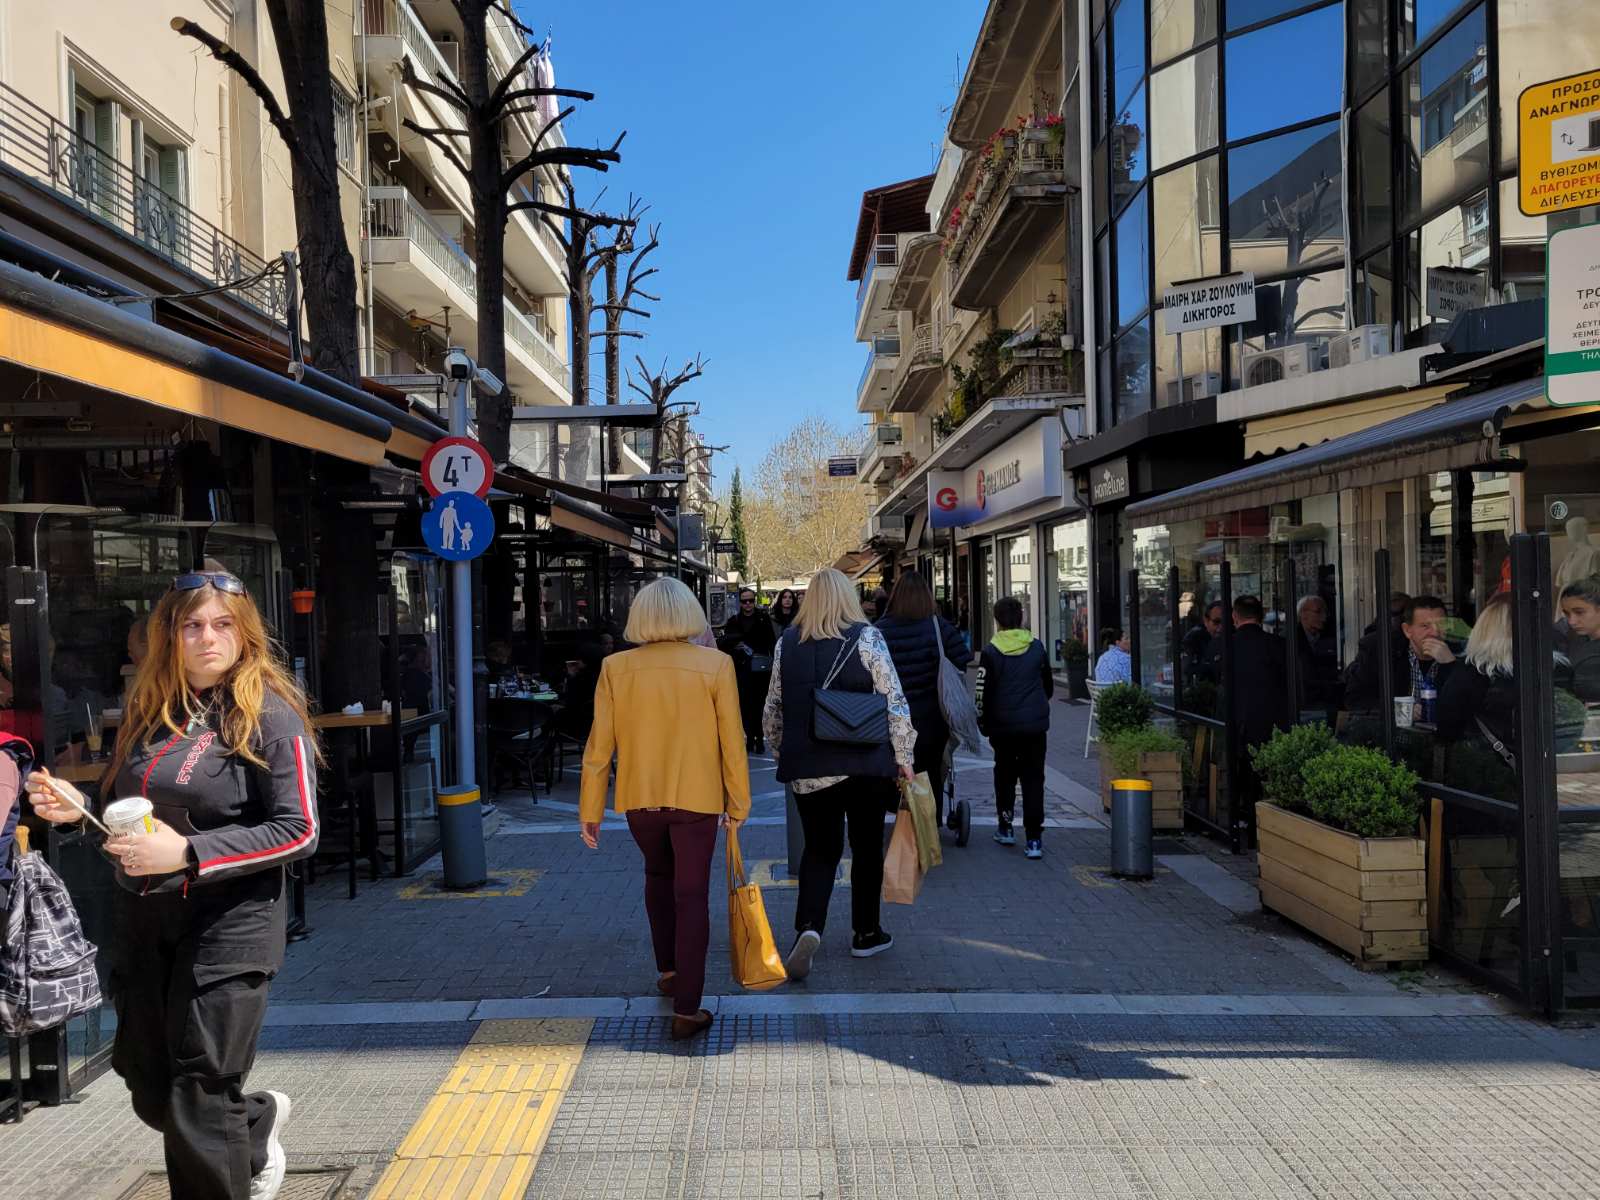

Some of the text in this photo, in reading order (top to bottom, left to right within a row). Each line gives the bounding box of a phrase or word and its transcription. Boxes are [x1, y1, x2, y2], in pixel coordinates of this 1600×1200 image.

[1540, 161, 1600, 180] ΒΥΘΙΖΟΜ
[1164, 281, 1254, 309] ΜΑΙΡΗ ΧΑΡ. ΖΟΥΛΟΥΜΗ
[1182, 303, 1236, 324] ΔΙΚΗΓΟΡΟΣ
[1576, 320, 1600, 329] ΔΕΥΤ
